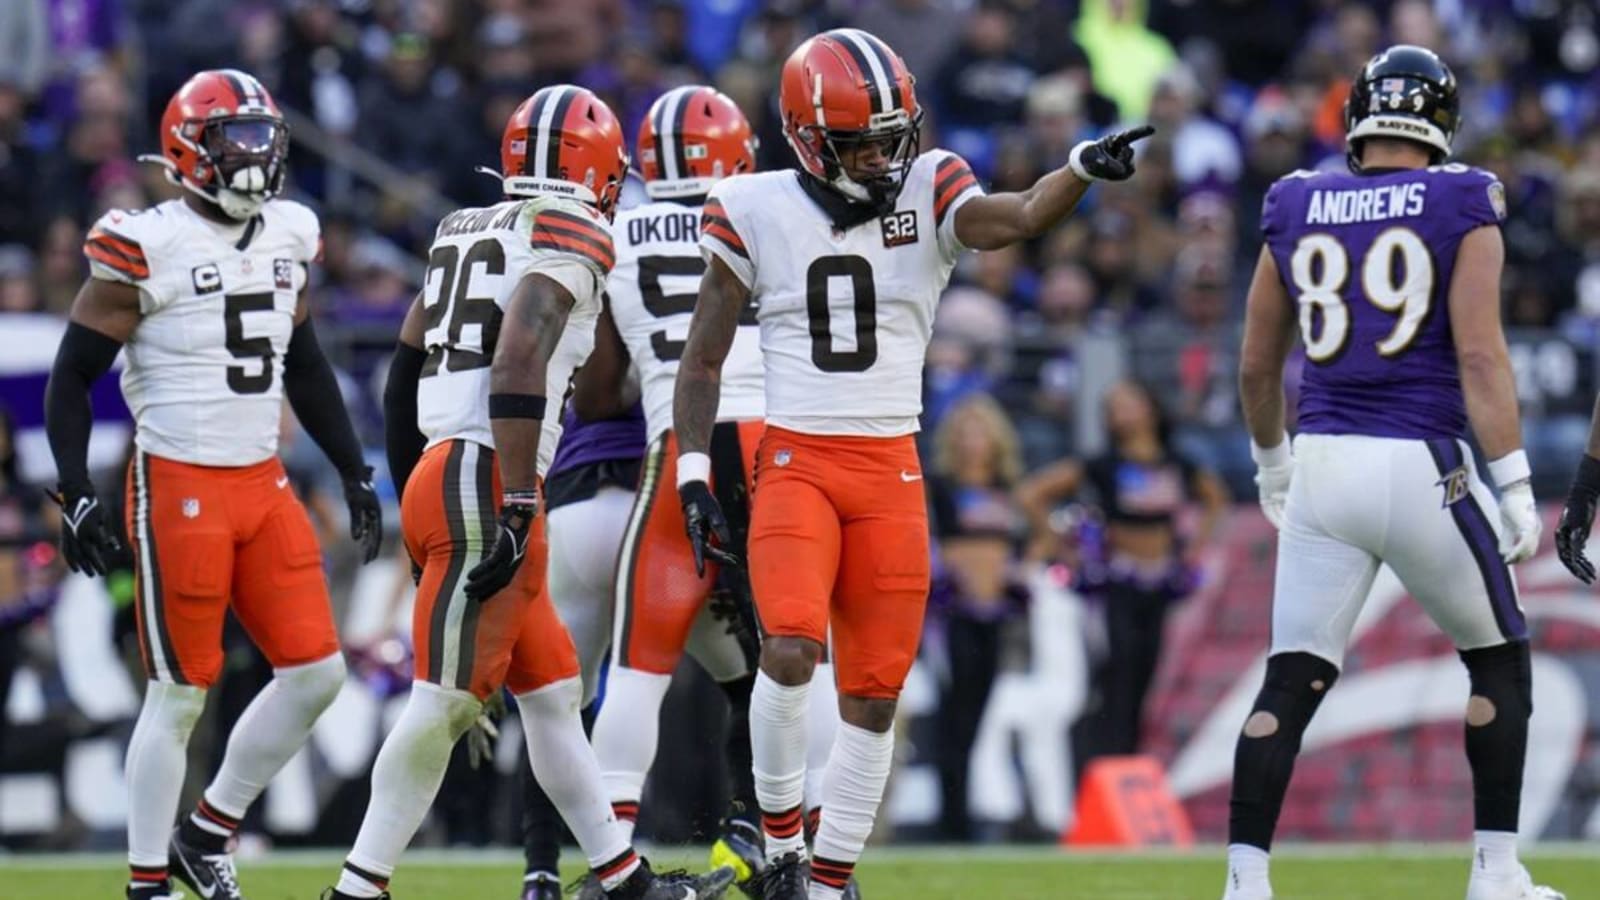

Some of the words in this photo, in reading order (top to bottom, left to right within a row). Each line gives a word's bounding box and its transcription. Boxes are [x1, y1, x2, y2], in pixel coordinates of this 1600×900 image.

[1376, 121, 1430, 136] RAVENS
[542, 183, 576, 195] CHANGE
[1306, 182, 1427, 224] ANDREWS
[883, 214, 915, 240] 32
[195, 265, 220, 288] C
[1291, 227, 1434, 361] 89
[420, 237, 506, 377] 26
[807, 254, 877, 373] 0
[224, 292, 275, 394] 5
